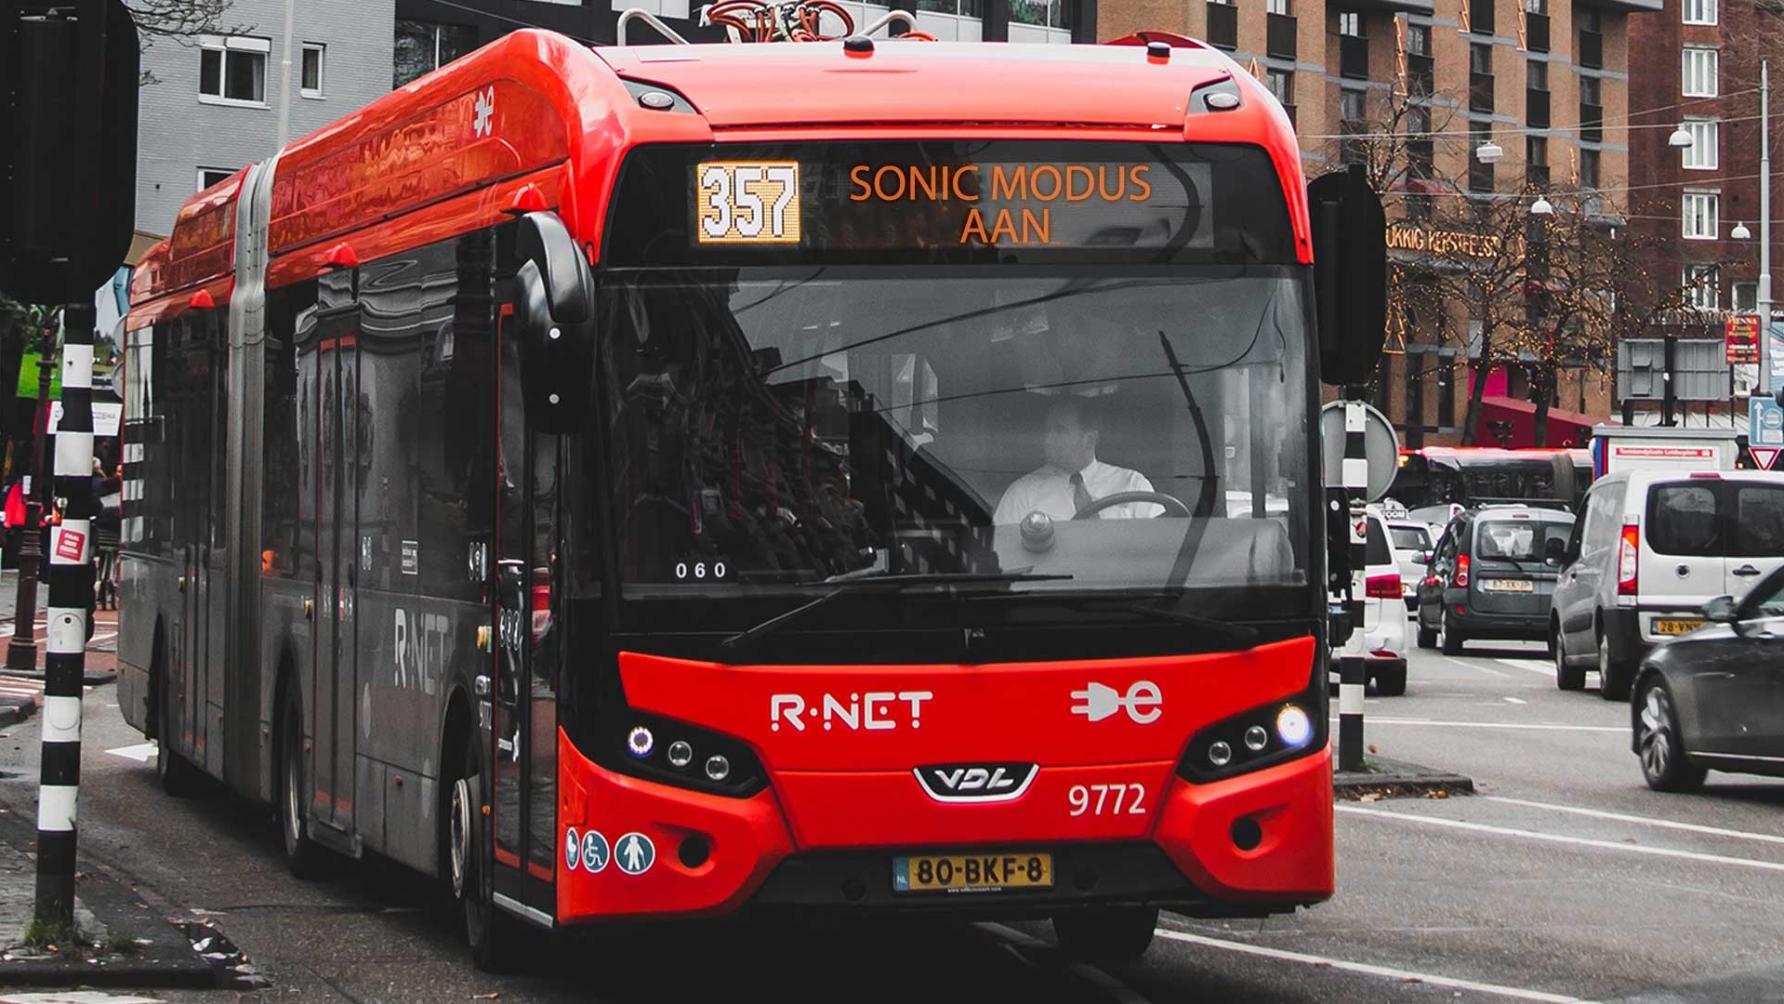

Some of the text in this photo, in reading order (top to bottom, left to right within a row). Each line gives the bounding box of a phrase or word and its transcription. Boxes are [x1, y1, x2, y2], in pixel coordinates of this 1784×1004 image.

[850, 164, 1153, 202] SONIC MODUS
[701, 166, 797, 239] 357
[960, 207, 1050, 244] AAN
[1385, 225, 1424, 250] UKKIG
[675, 562, 726, 579] 060
[934, 767, 1015, 791] VDL
[1068, 783, 1147, 817] 9772
[916, 855, 1044, 886] 80-BKF-8
